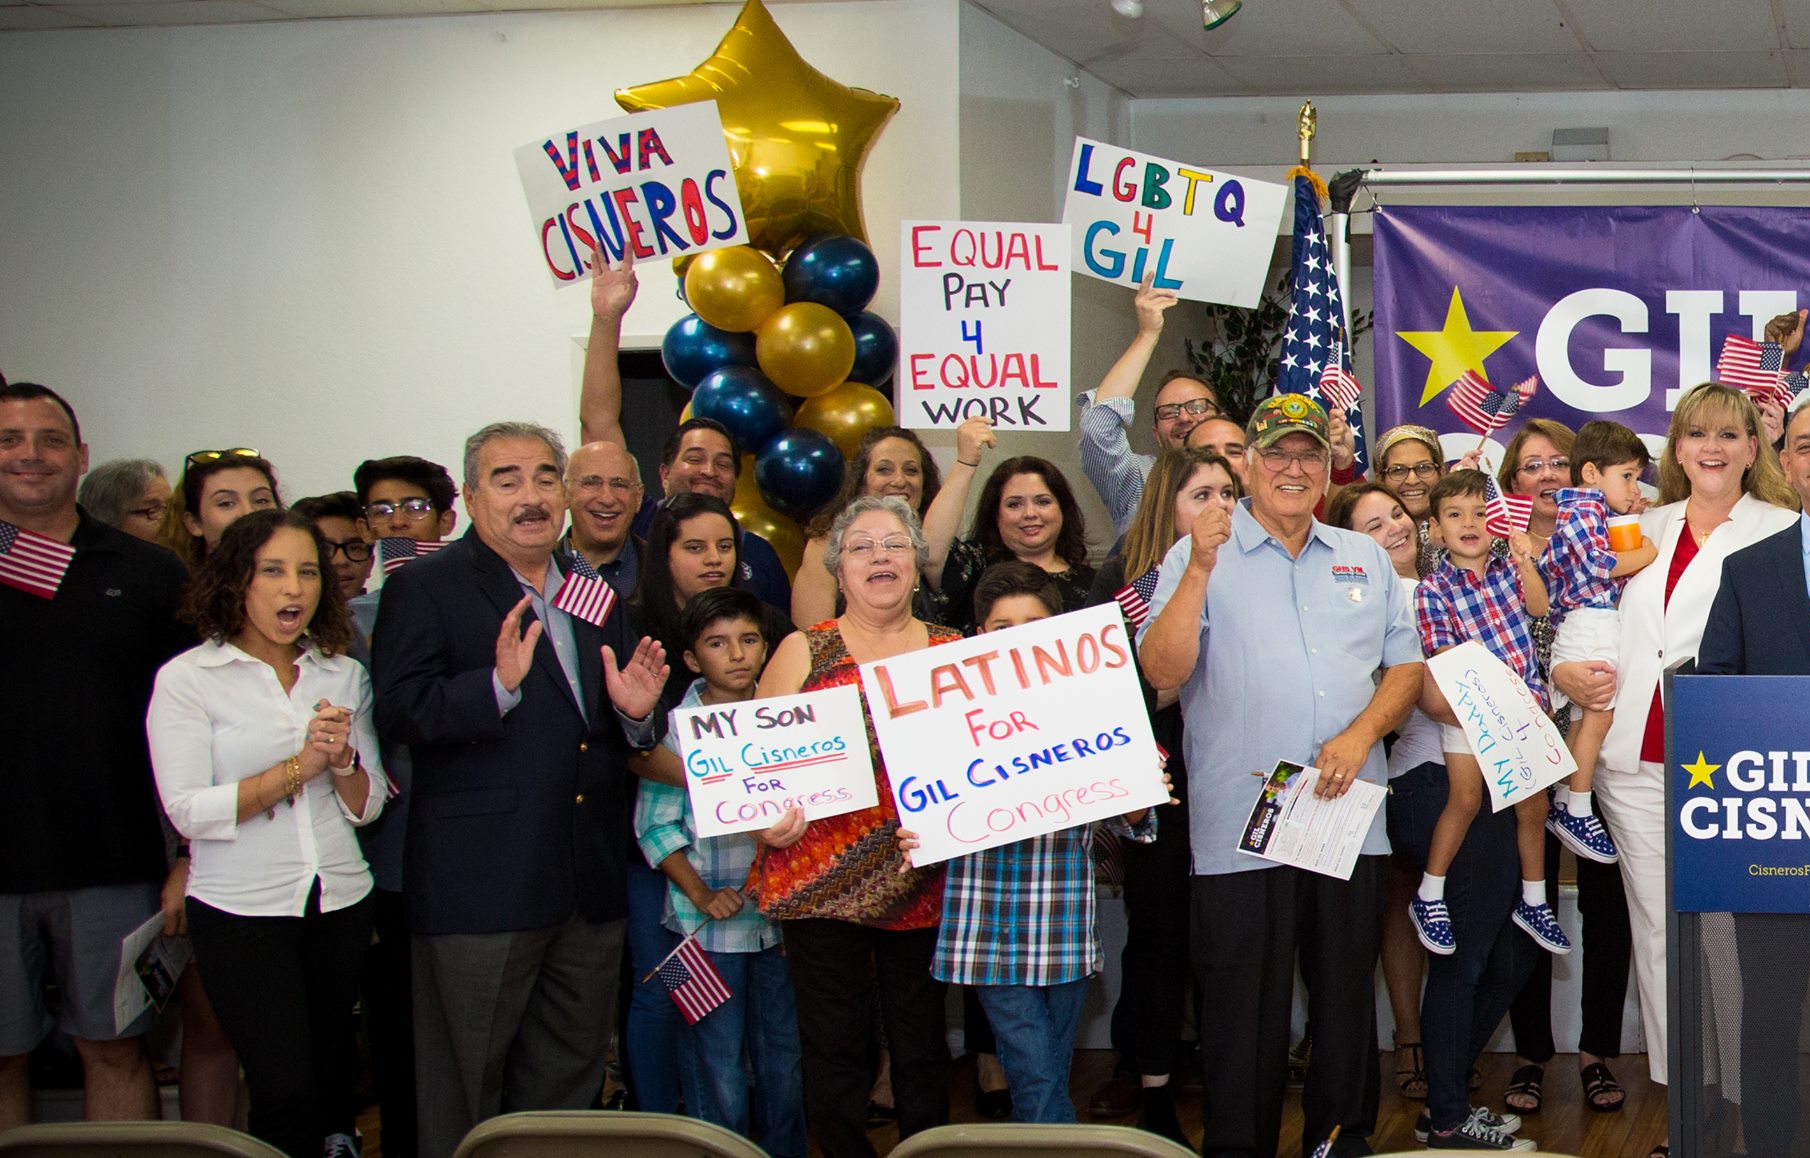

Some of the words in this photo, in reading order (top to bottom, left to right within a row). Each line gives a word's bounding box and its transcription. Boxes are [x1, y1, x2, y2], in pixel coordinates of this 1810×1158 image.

[543, 128, 674, 191] VIVA
[1074, 143, 1246, 228] LGBTQ
[542, 169, 737, 280] CISNEROS
[1133, 210, 1153, 245] 4
[912, 225, 1058, 271] EQUAL
[1083, 220, 1184, 291] GIL
[943, 272, 1011, 311] PAY
[961, 320, 983, 355] 4
[910, 353, 1058, 390] EQUAL
[921, 394, 1047, 427] WORK
[872, 623, 1128, 720] LATINOS
[690, 708, 738, 740] MY
[755, 704, 817, 729] SON
[964, 708, 1039, 747] FOR
[687, 749, 734, 778] GIL
[741, 735, 846, 767] Cisneros
[898, 775, 960, 813] GIL
[966, 726, 1131, 788] CISNEROS
[742, 776, 787, 794] FOR
[716, 787, 853, 824] Congress
[947, 777, 1129, 844] Congress
[1254, 808, 1275, 848] CISNEROS
